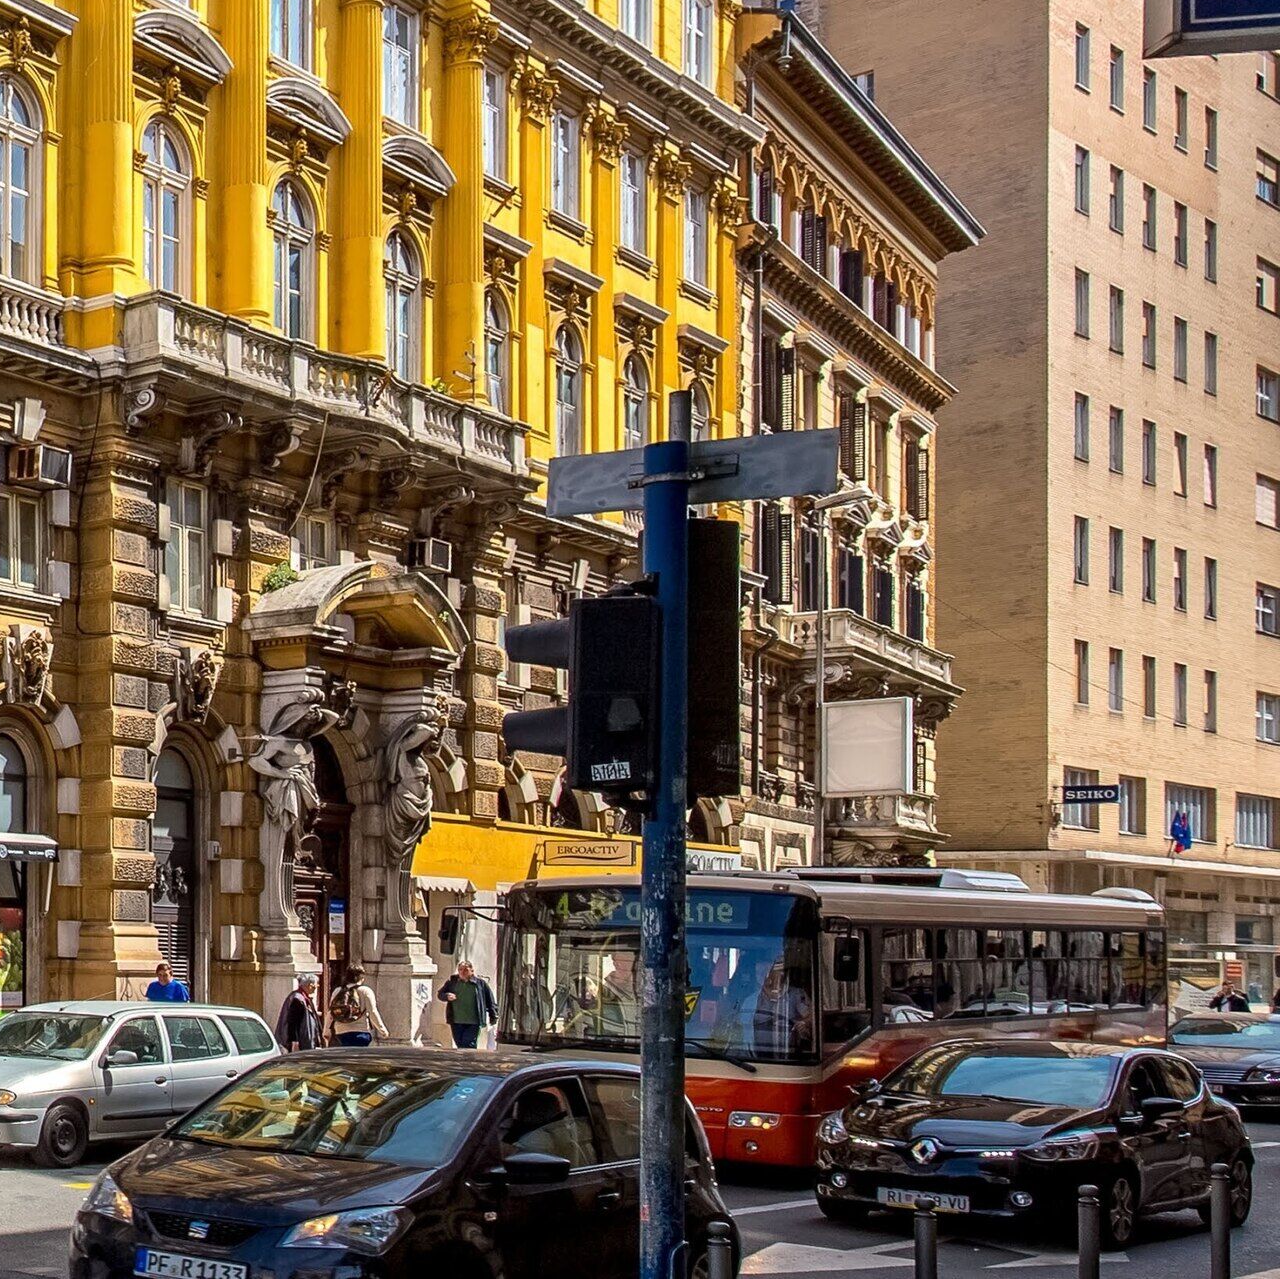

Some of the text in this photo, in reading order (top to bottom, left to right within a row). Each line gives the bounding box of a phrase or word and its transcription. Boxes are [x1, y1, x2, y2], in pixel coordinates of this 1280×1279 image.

[1065, 789, 1116, 800] SEIKO
[557, 845, 620, 855] ERGOACTIV
[887, 1190, 902, 1204] RI
[147, 1252, 170, 1273] PF
